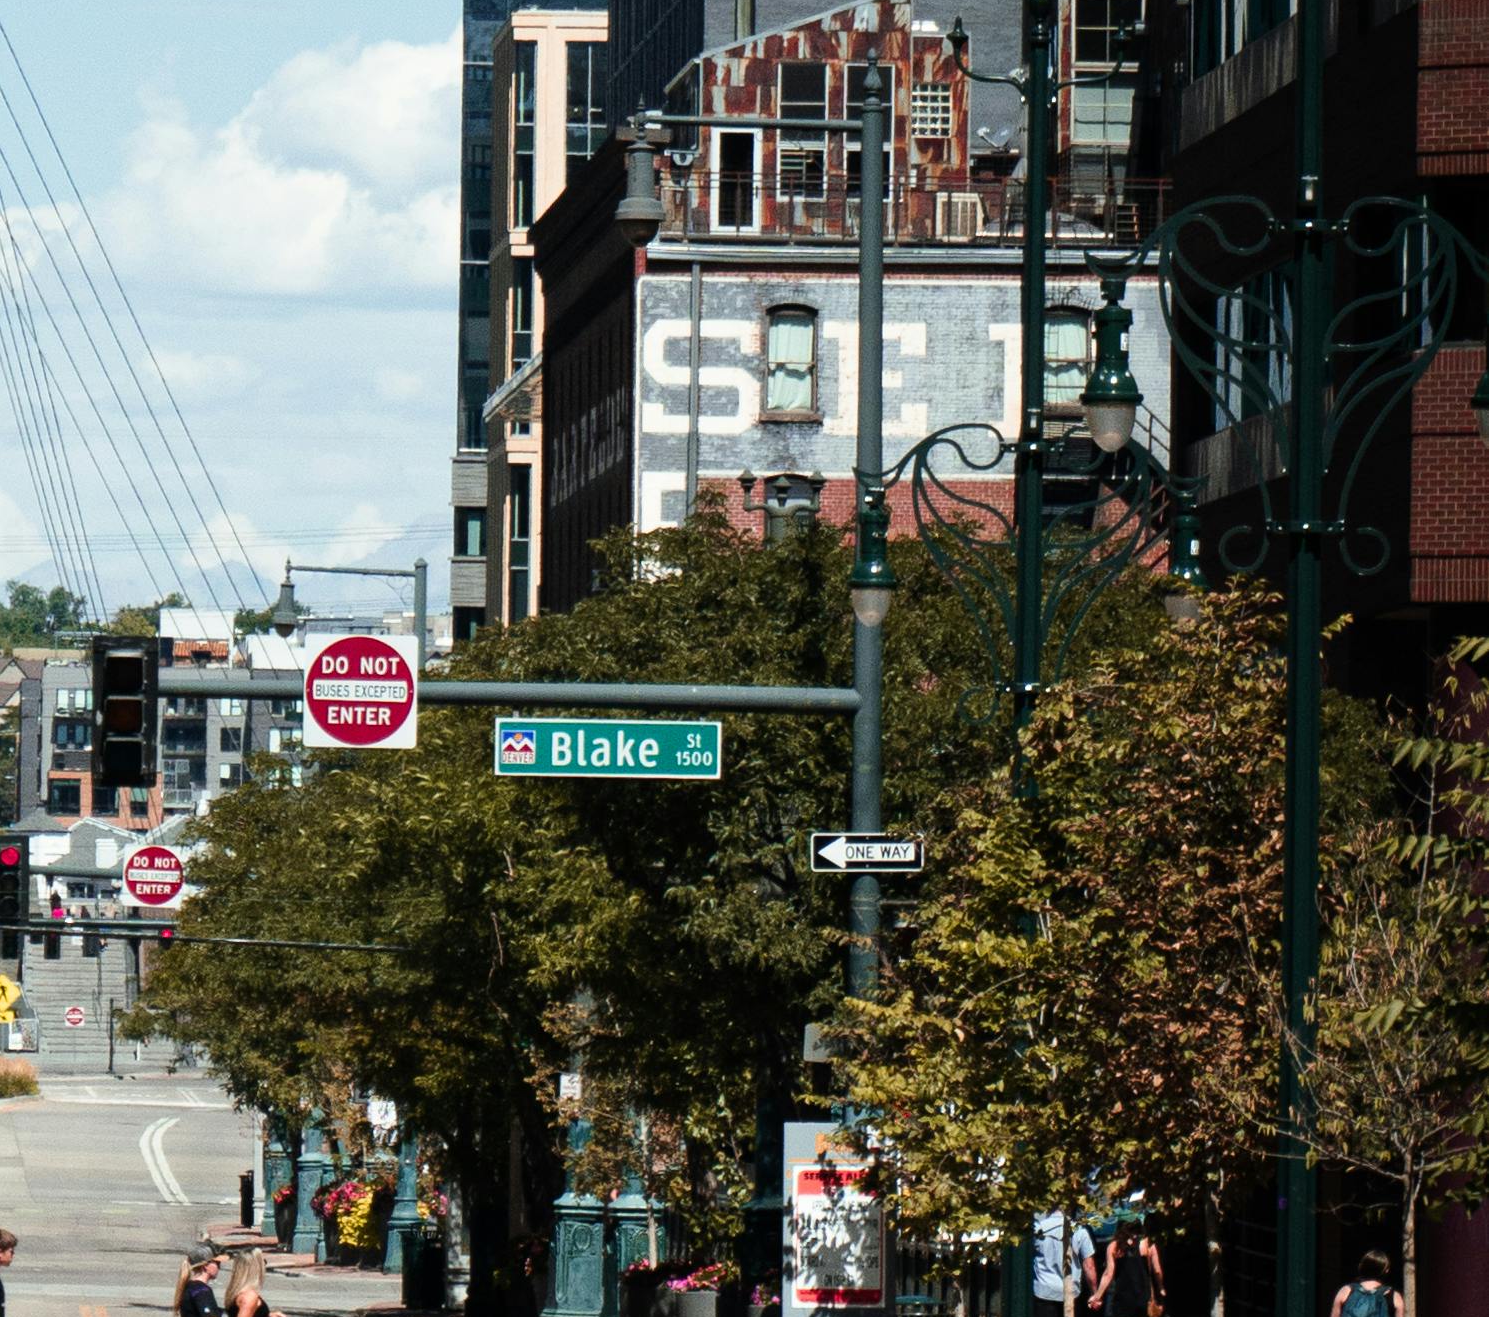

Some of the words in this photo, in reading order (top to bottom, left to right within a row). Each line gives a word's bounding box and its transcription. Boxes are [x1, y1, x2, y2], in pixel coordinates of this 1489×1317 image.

[322, 656, 349, 674] DO
[360, 656, 400, 675] NOT
[315, 684, 350, 698] BUSES
[355, 685, 406, 699] EXCEPTED
[327, 706, 391, 726] ENTER
[551, 730, 660, 768] Blake
[686, 733, 702, 749] St
[502, 751, 534, 763] DENVER
[676, 751, 713, 767] 1500
[846, 846, 874, 859] ONE
[880, 846, 911, 859] WAY
[133, 856, 149, 867] DO
[154, 857, 176, 869] NOT
[136, 884, 171, 895] ENTER
